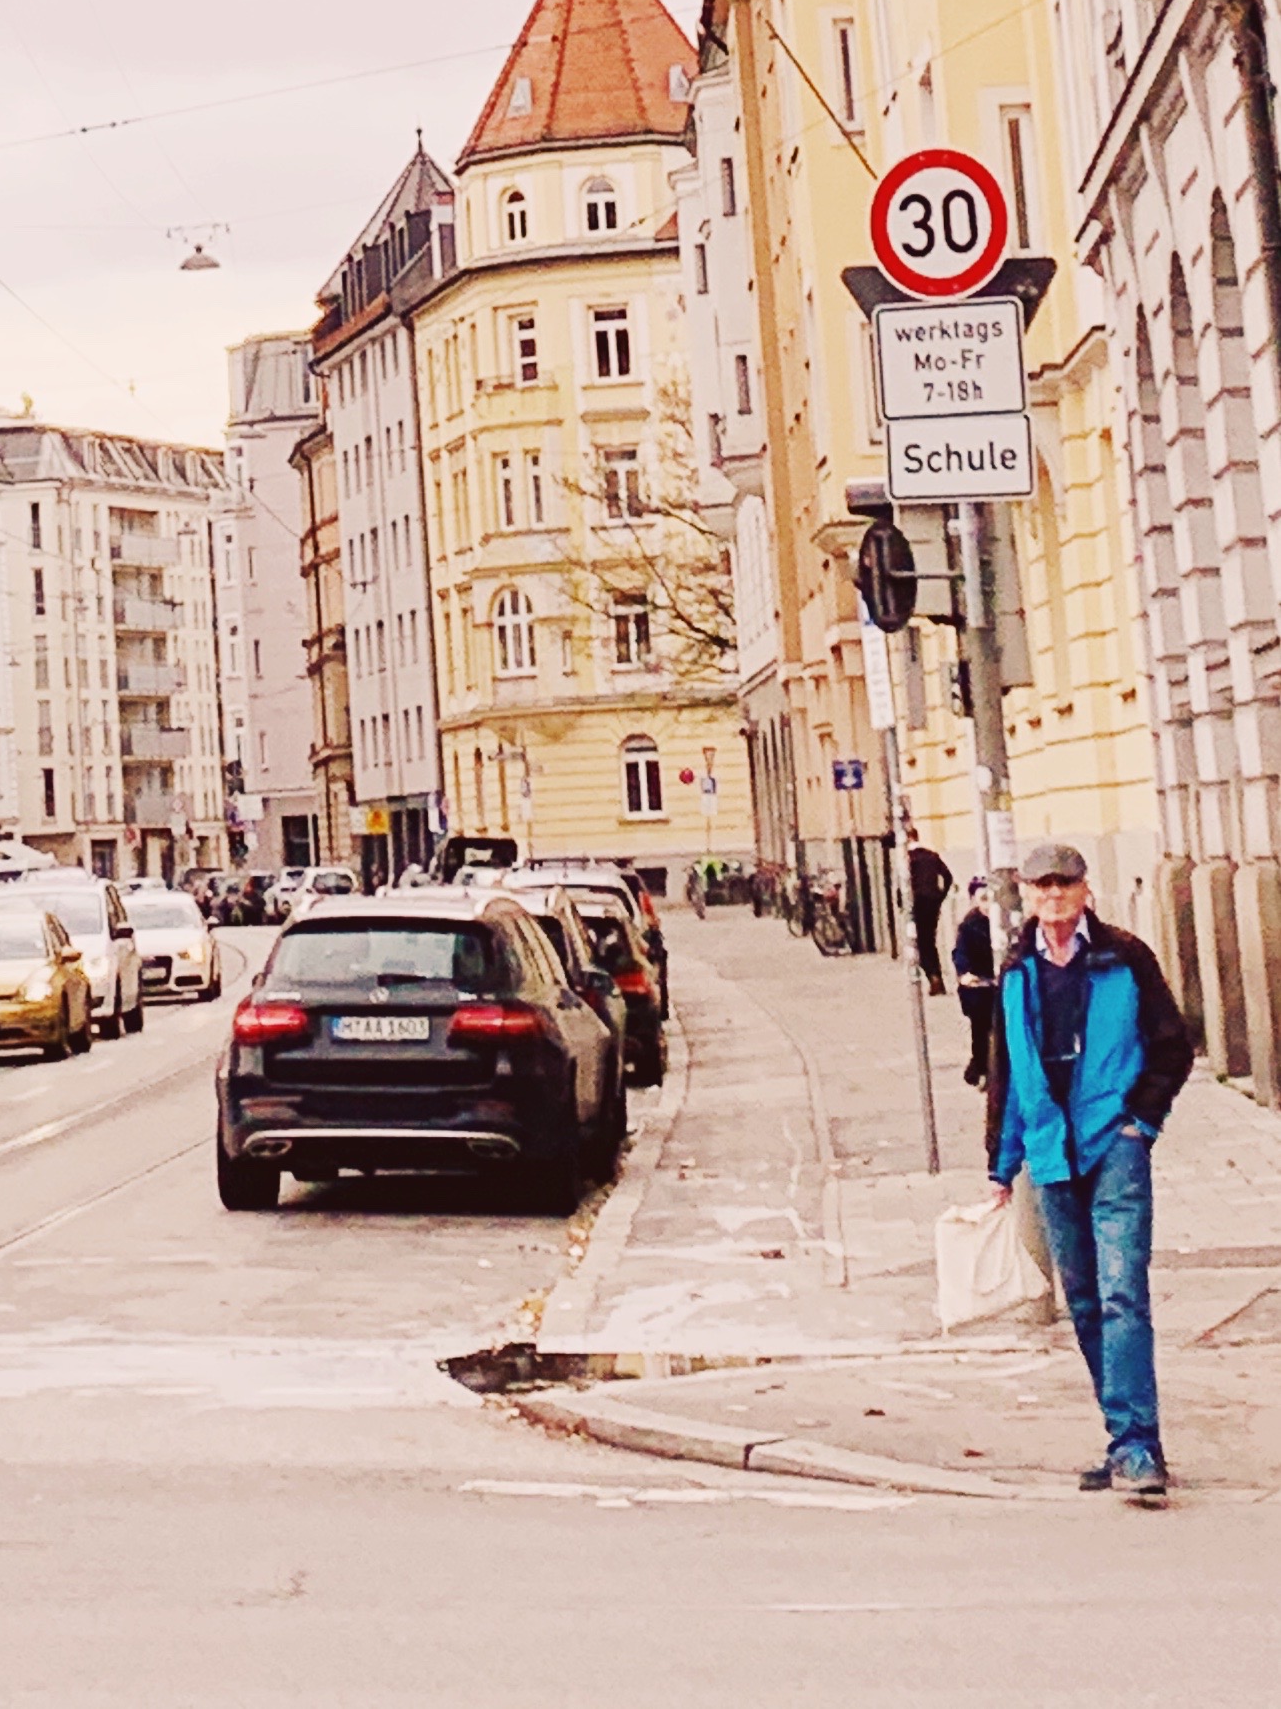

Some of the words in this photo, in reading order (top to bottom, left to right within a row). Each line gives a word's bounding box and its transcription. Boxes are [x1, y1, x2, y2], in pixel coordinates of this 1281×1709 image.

[898, 189, 979, 258] 30
[894, 319, 1005, 346] werktags
[914, 350, 987, 372] Mo-Fr
[922, 381, 984, 404] 7-18h
[902, 441, 1019, 475] Schule
